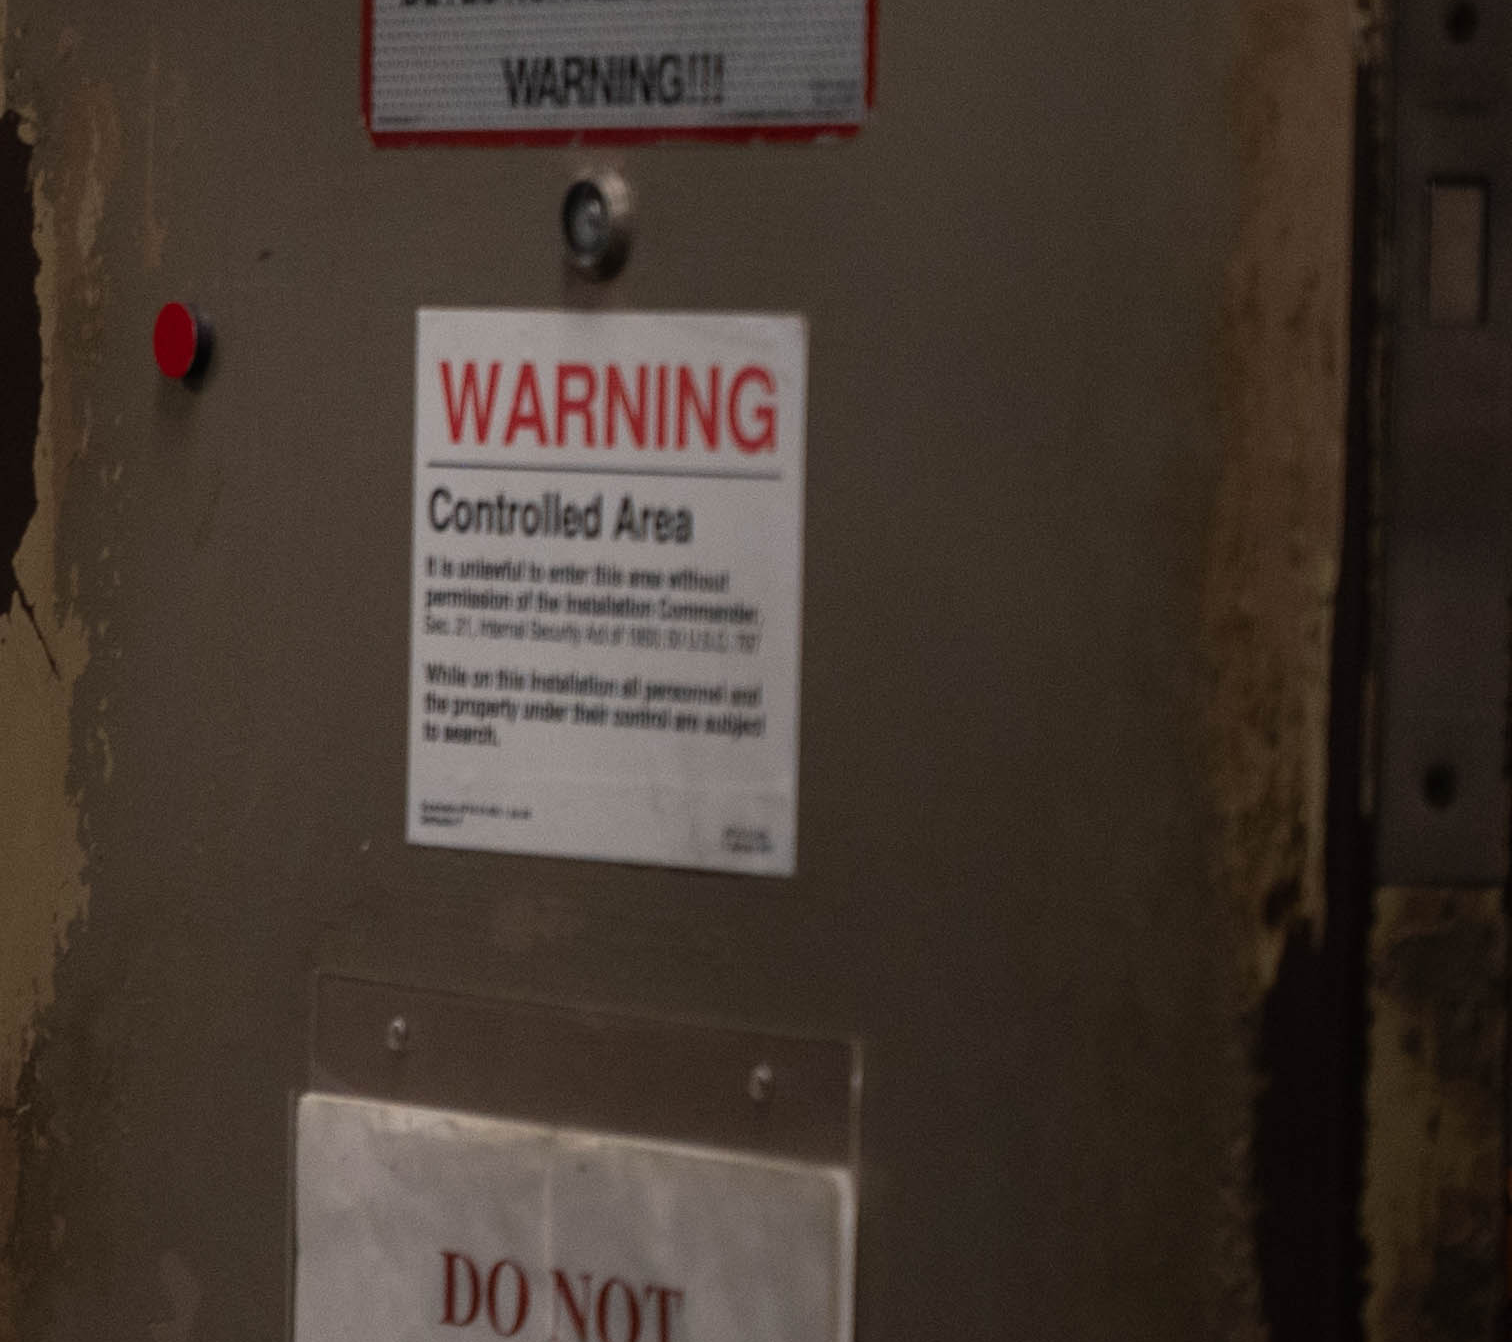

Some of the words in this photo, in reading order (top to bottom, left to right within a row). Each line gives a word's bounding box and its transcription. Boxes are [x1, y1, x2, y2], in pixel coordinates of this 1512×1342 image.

[503, 54, 724, 108] WARNING!!!
[440, 361, 777, 455] WARNING
[428, 488, 602, 540] Controlled
[613, 496, 694, 544] Area
[426, 589, 510, 611] permission
[669, 567, 729, 593] without
[426, 662, 465, 685] While
[453, 696, 517, 722] property
[441, 1250, 530, 1339] DO
